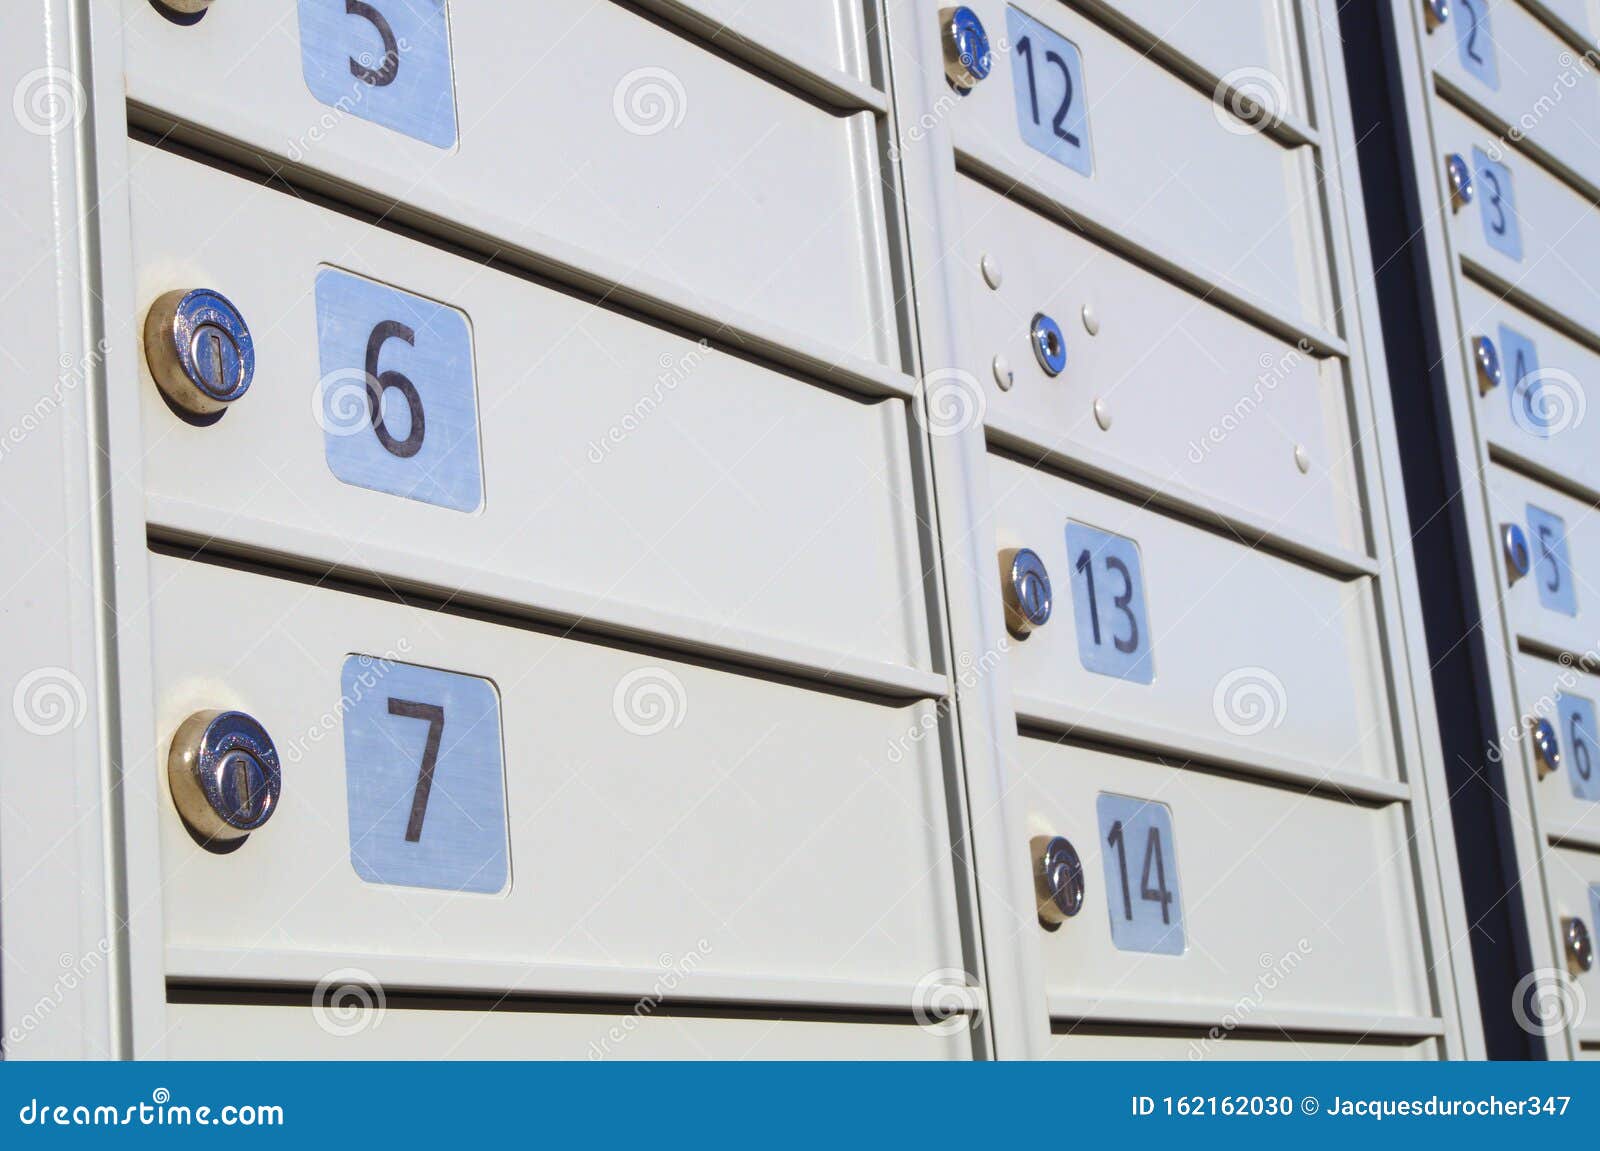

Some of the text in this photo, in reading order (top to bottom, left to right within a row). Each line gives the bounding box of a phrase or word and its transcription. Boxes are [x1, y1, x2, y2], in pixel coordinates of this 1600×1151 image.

[344, 0, 400, 87] 5
[1460, 0, 1482, 65] 2
[1016, 35, 1081, 147] 12
[1484, 169, 1506, 236] 3
[364, 319, 426, 459] 6
[1075, 549, 1139, 654] 13
[1538, 524, 1560, 593] 5
[388, 697, 445, 843] 7
[1570, 712, 1592, 781] 6
[1107, 820, 1174, 925] 14
